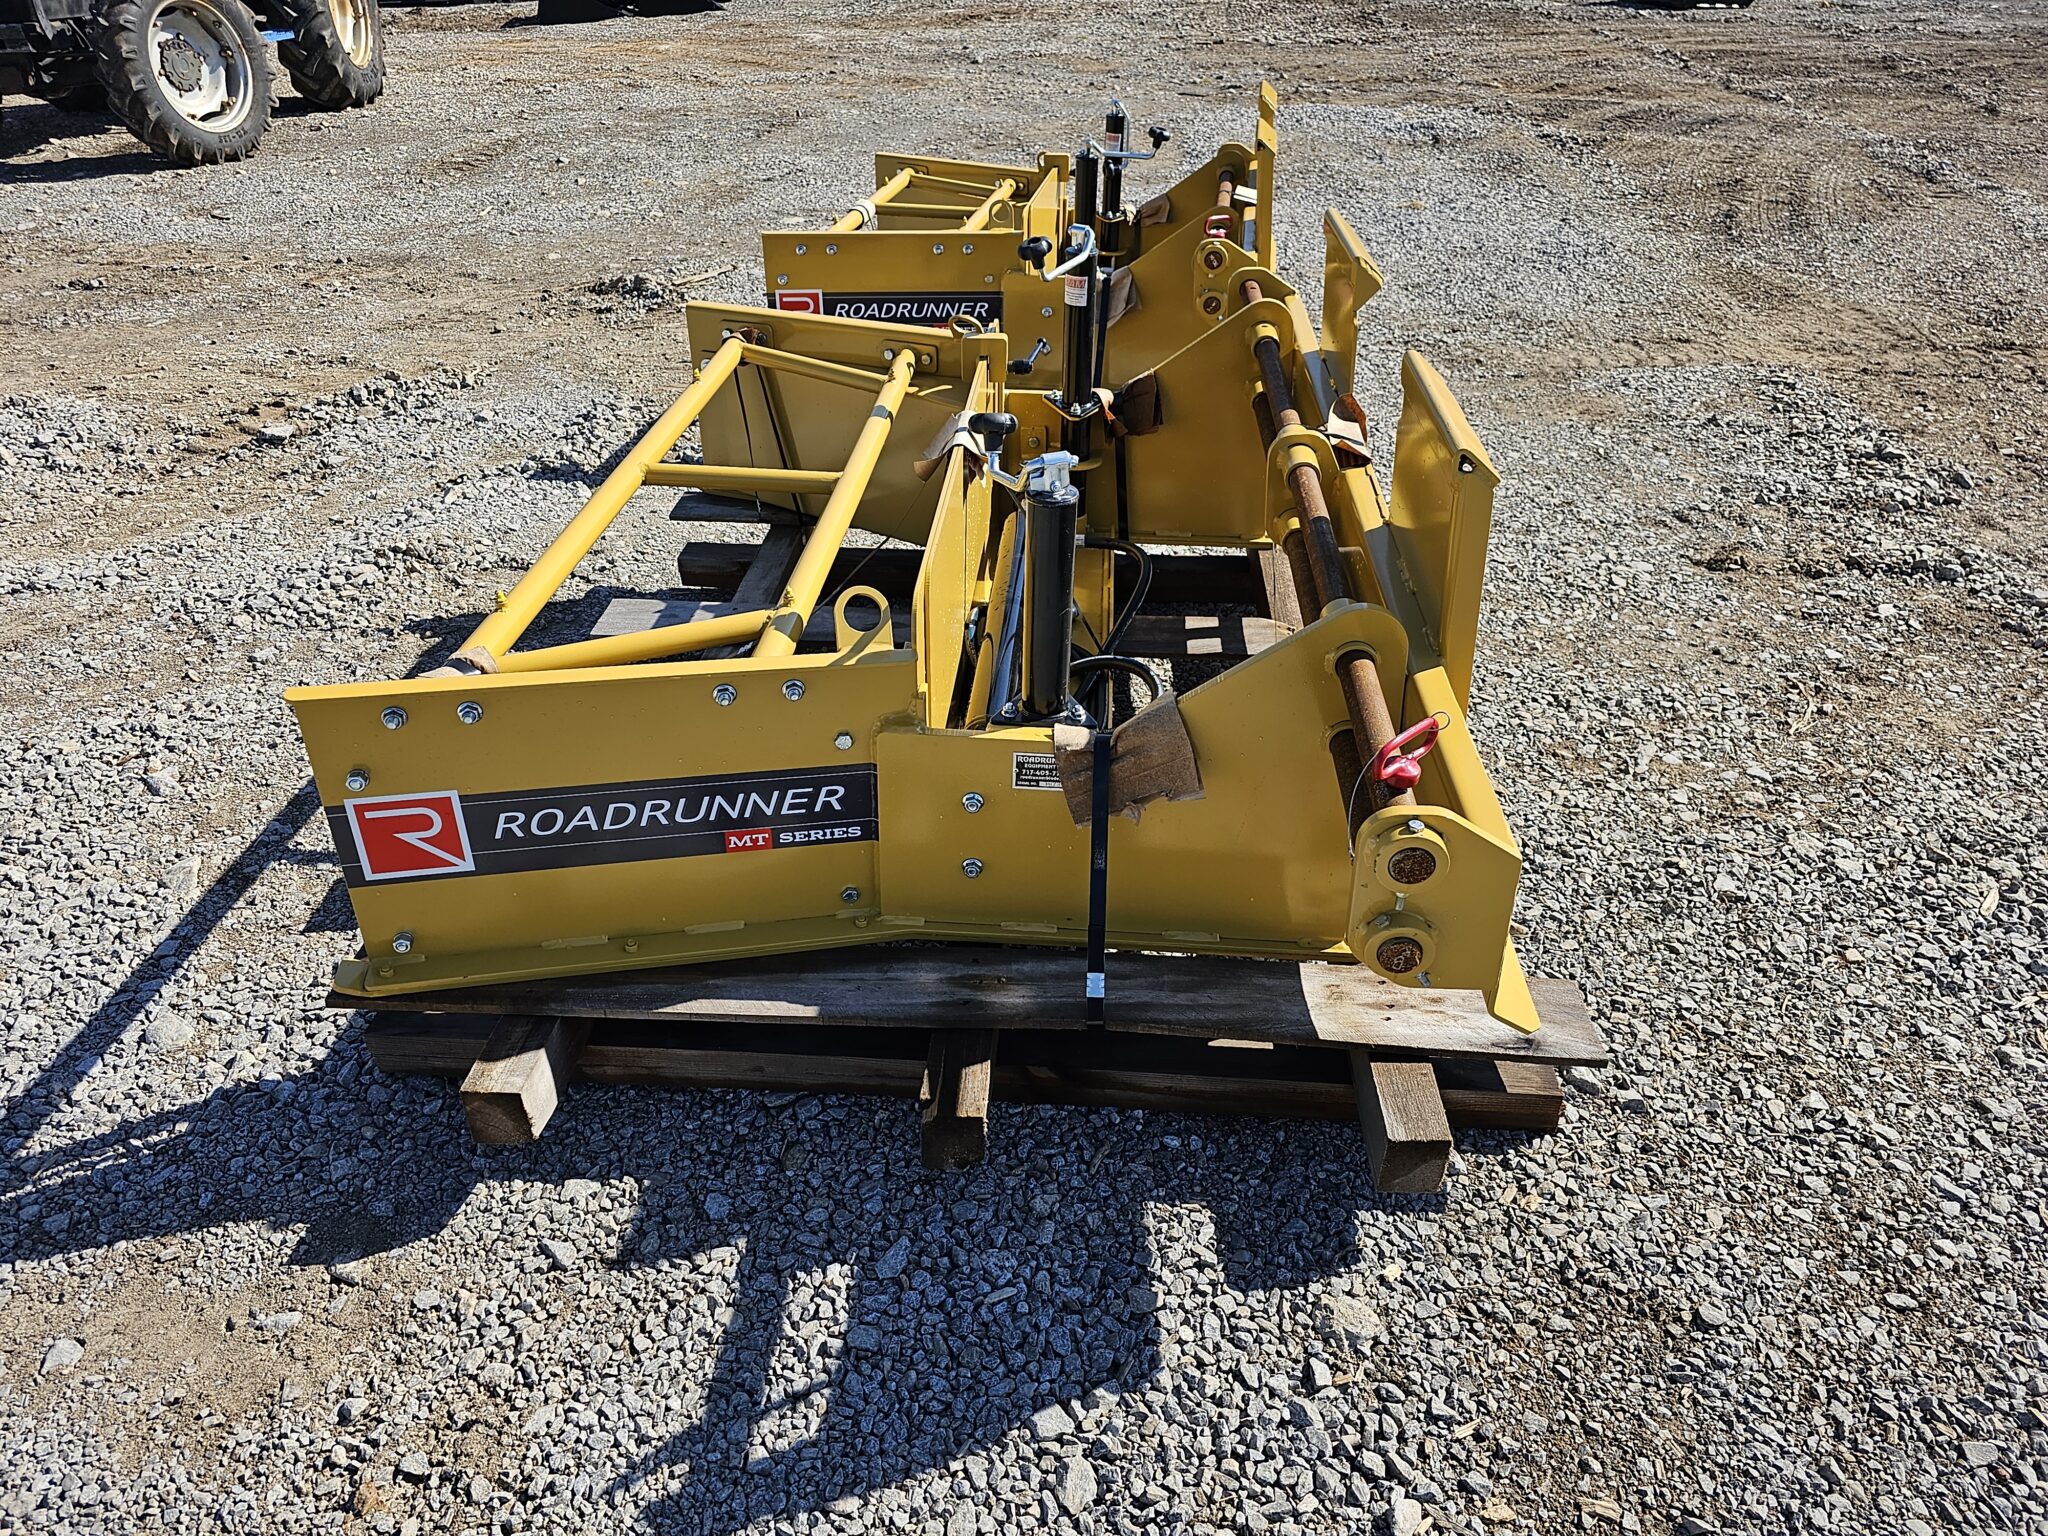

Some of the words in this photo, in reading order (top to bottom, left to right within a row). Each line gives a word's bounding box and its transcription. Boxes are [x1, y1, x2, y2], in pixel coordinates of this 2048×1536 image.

[834, 302, 989, 318] ROADRUNNER
[1017, 756, 1056, 764] ROADRUN
[494, 785, 846, 840] ROADRUNNER
[728, 833, 769, 849] MT
[779, 826, 862, 844] SERIES
